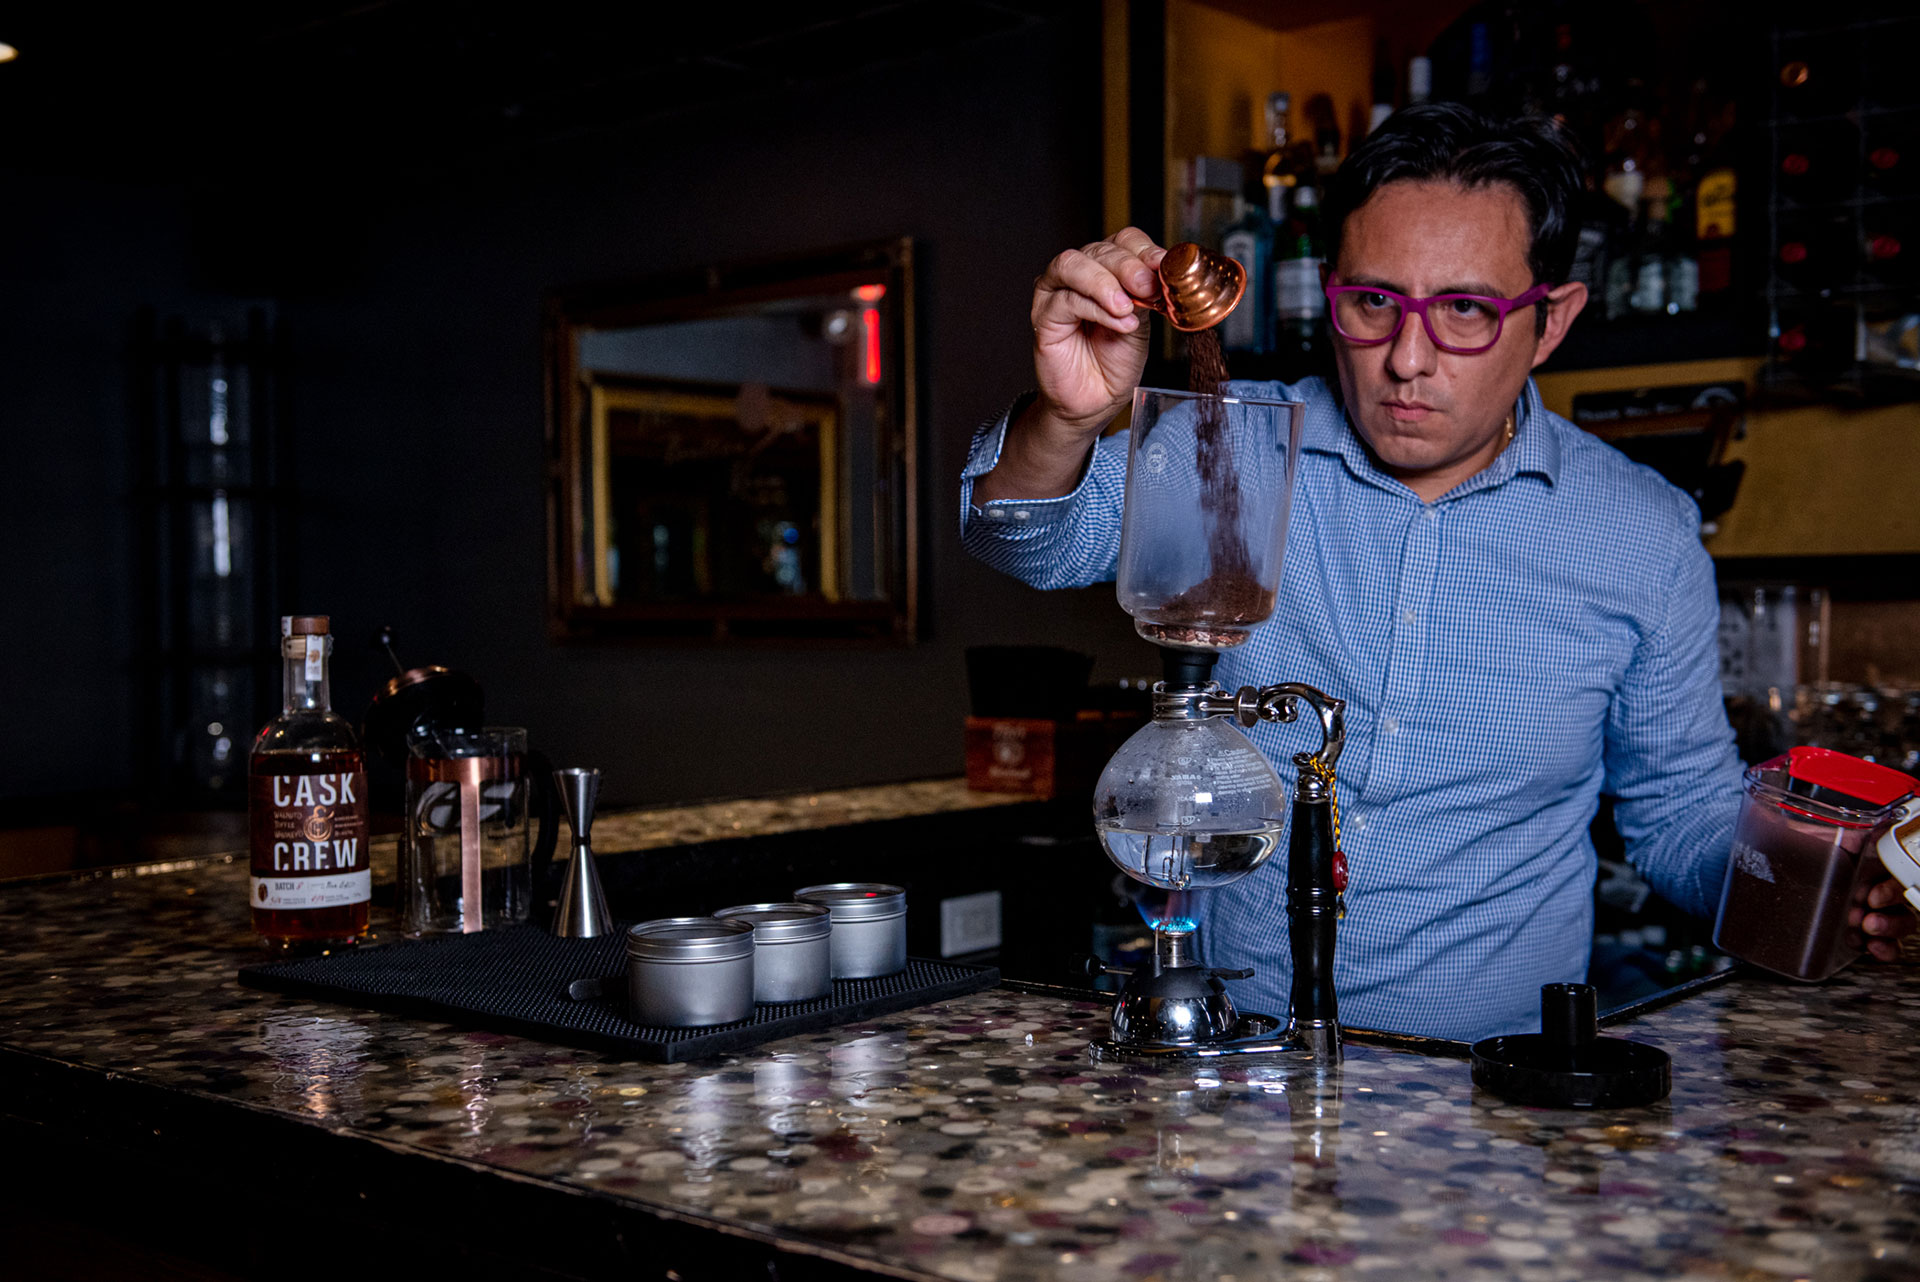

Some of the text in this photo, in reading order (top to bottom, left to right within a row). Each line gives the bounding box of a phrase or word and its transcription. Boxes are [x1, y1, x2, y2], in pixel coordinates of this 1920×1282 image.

[273, 772, 356, 807] CASK
[274, 838, 358, 871] CREW
[275, 882, 295, 891] BATCH
